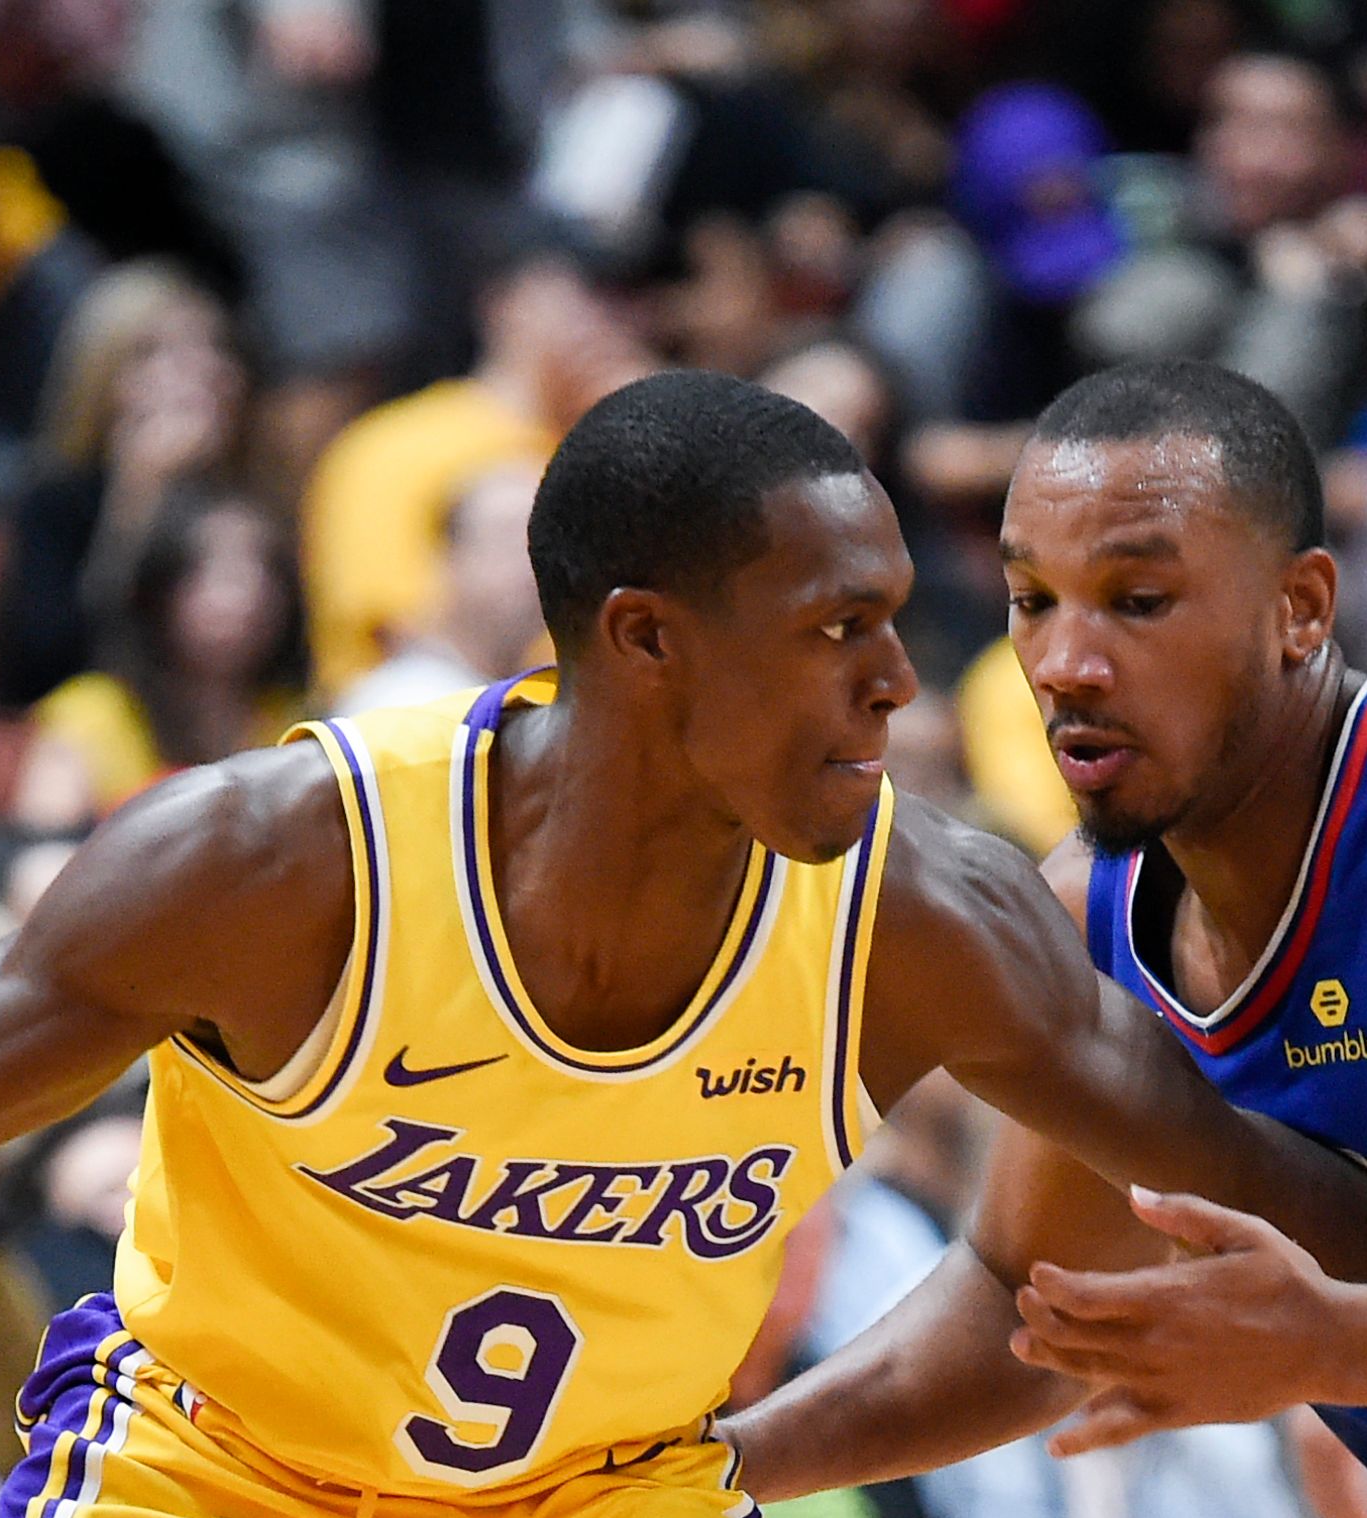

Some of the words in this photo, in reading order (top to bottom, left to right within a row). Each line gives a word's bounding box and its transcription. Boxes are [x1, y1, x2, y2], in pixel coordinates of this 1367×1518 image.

[695, 1055, 806, 1099] wish
[292, 1115, 797, 1261] LAKERS
[392, 1283, 585, 1488] 9
